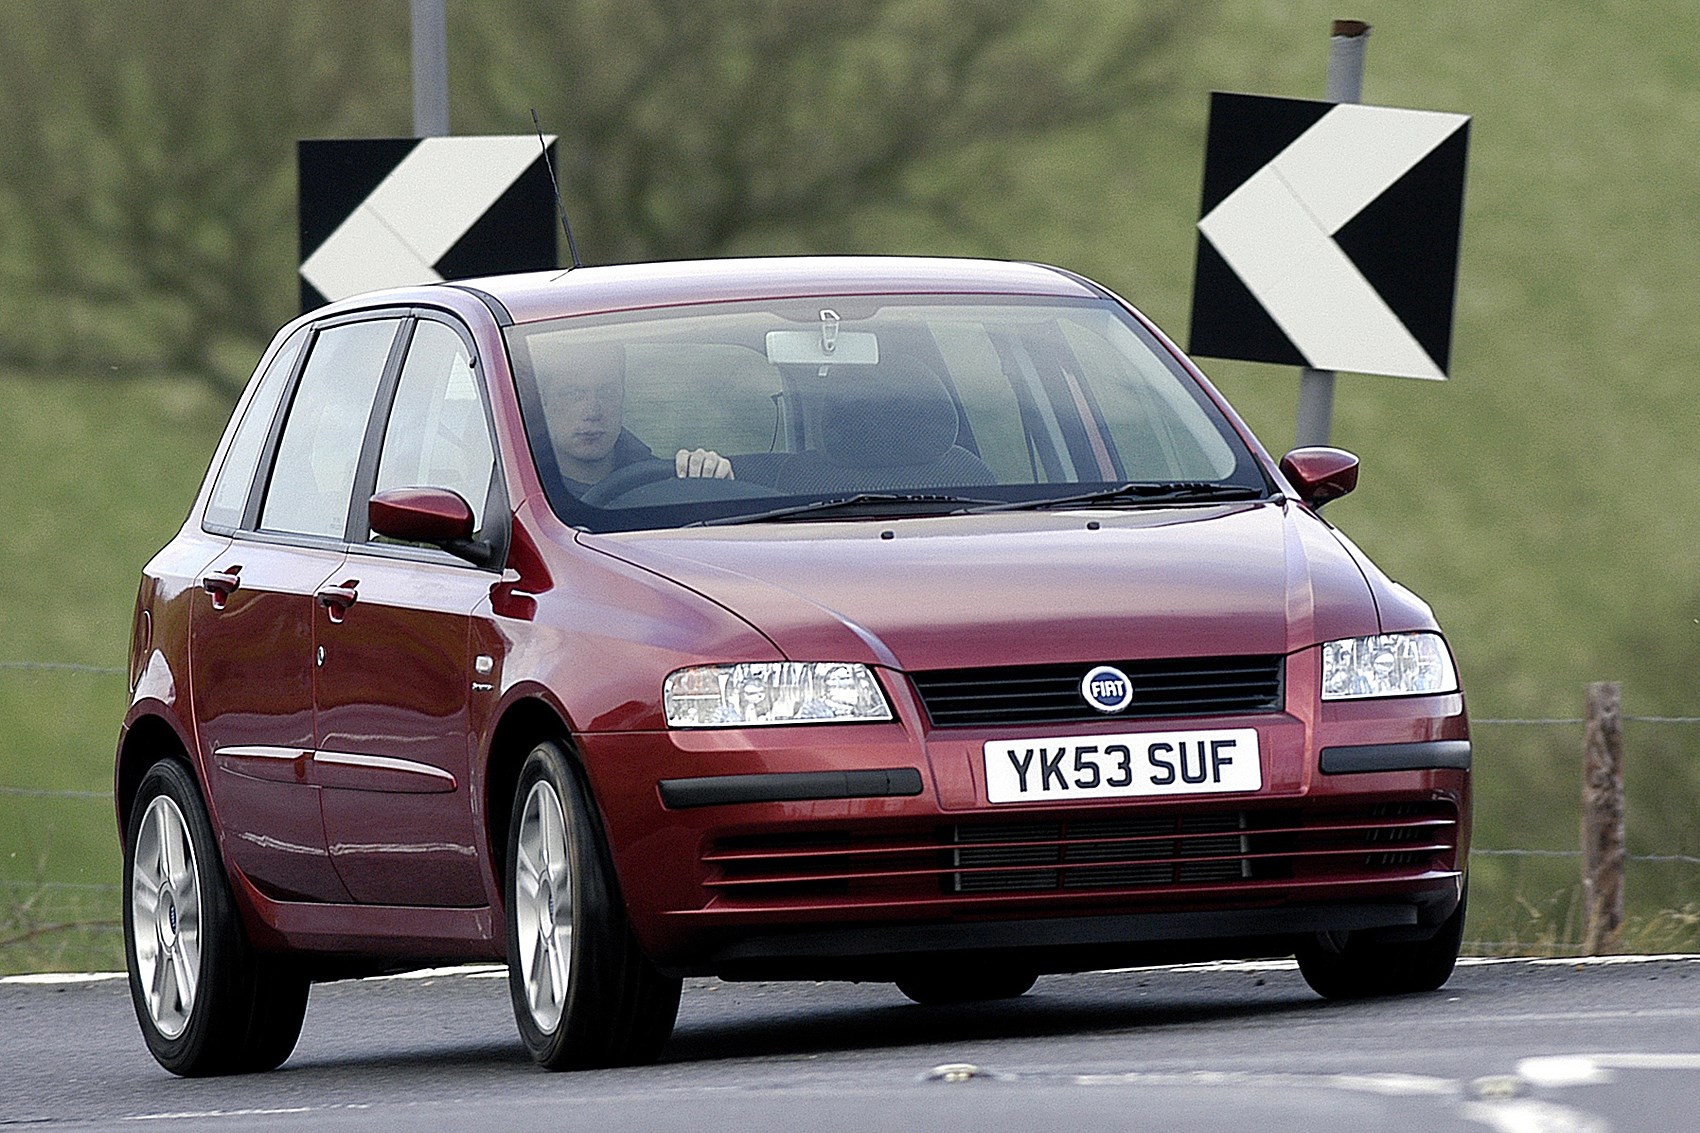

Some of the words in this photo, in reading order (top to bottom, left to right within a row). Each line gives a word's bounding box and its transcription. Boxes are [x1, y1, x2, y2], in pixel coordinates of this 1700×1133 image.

[1091, 680, 1124, 698] FIAT
[1007, 744, 1132, 792] YK53
[1147, 739, 1237, 785] SUF
